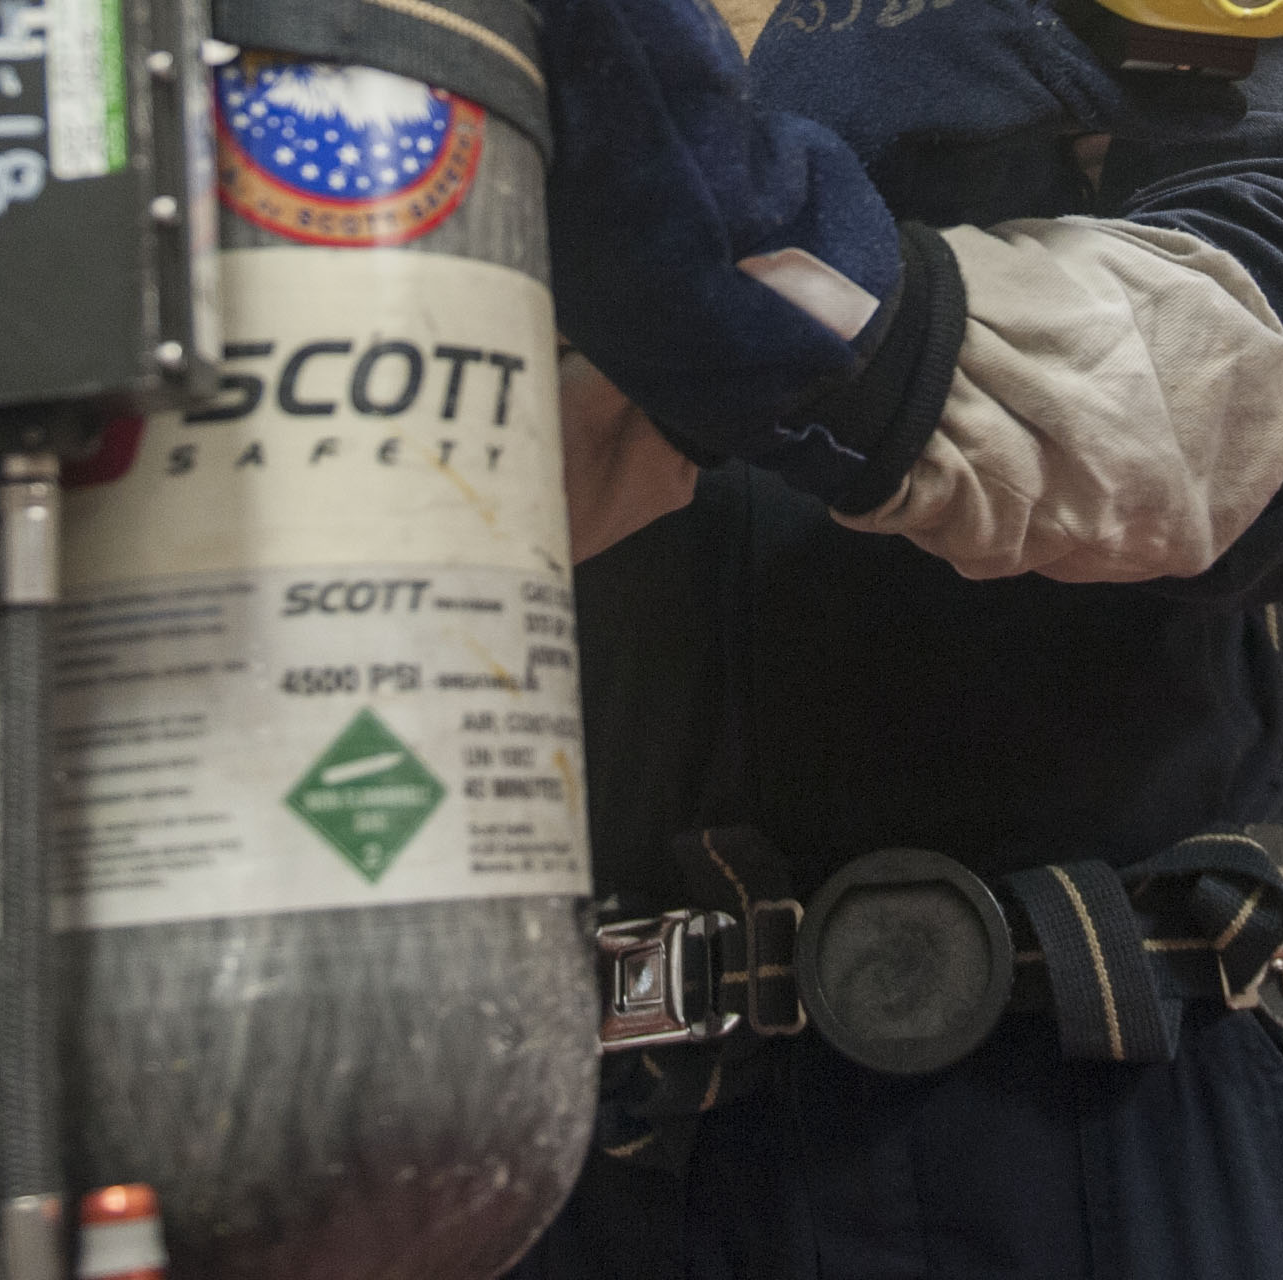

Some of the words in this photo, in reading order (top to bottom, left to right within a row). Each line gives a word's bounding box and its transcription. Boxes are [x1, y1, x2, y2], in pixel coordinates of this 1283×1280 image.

[182, 340, 526, 427] SCOTT
[166, 437, 506, 477] SAFETY
[280, 578, 432, 618] SCOTT
